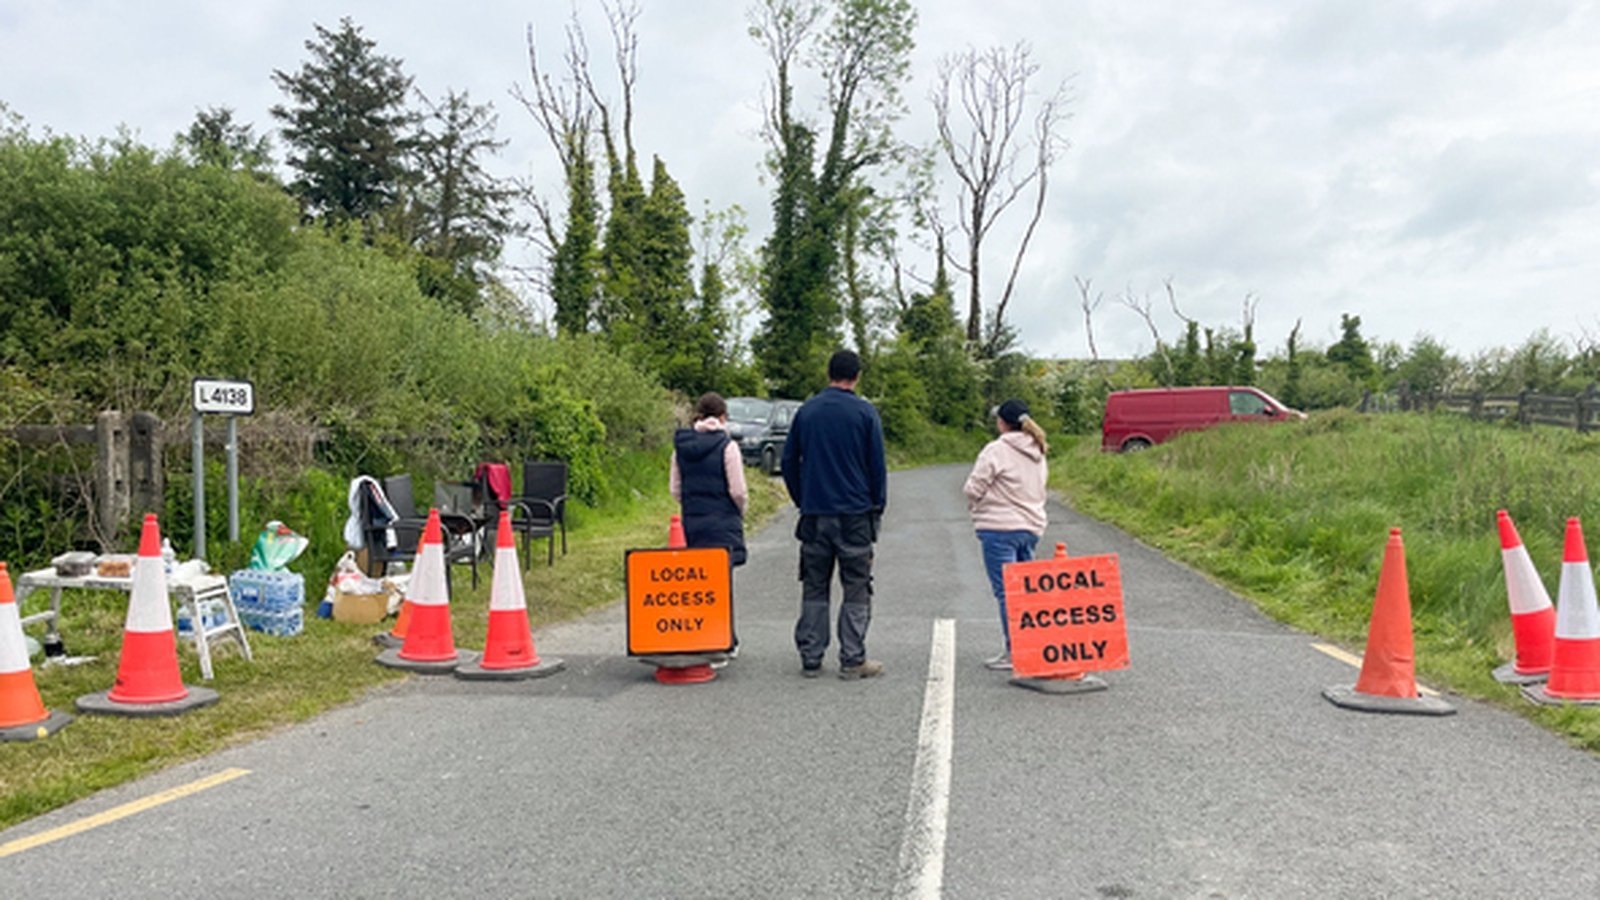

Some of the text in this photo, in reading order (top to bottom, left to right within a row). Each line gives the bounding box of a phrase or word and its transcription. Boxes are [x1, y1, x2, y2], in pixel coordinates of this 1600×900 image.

[651, 567, 707, 582] LOCAL
[1024, 570, 1104, 593] LOCAL
[643, 591, 715, 606] ACCESS
[656, 617, 703, 633] ONLY
[1020, 604, 1116, 630] ACCESS
[1043, 640, 1107, 663] ONLY
